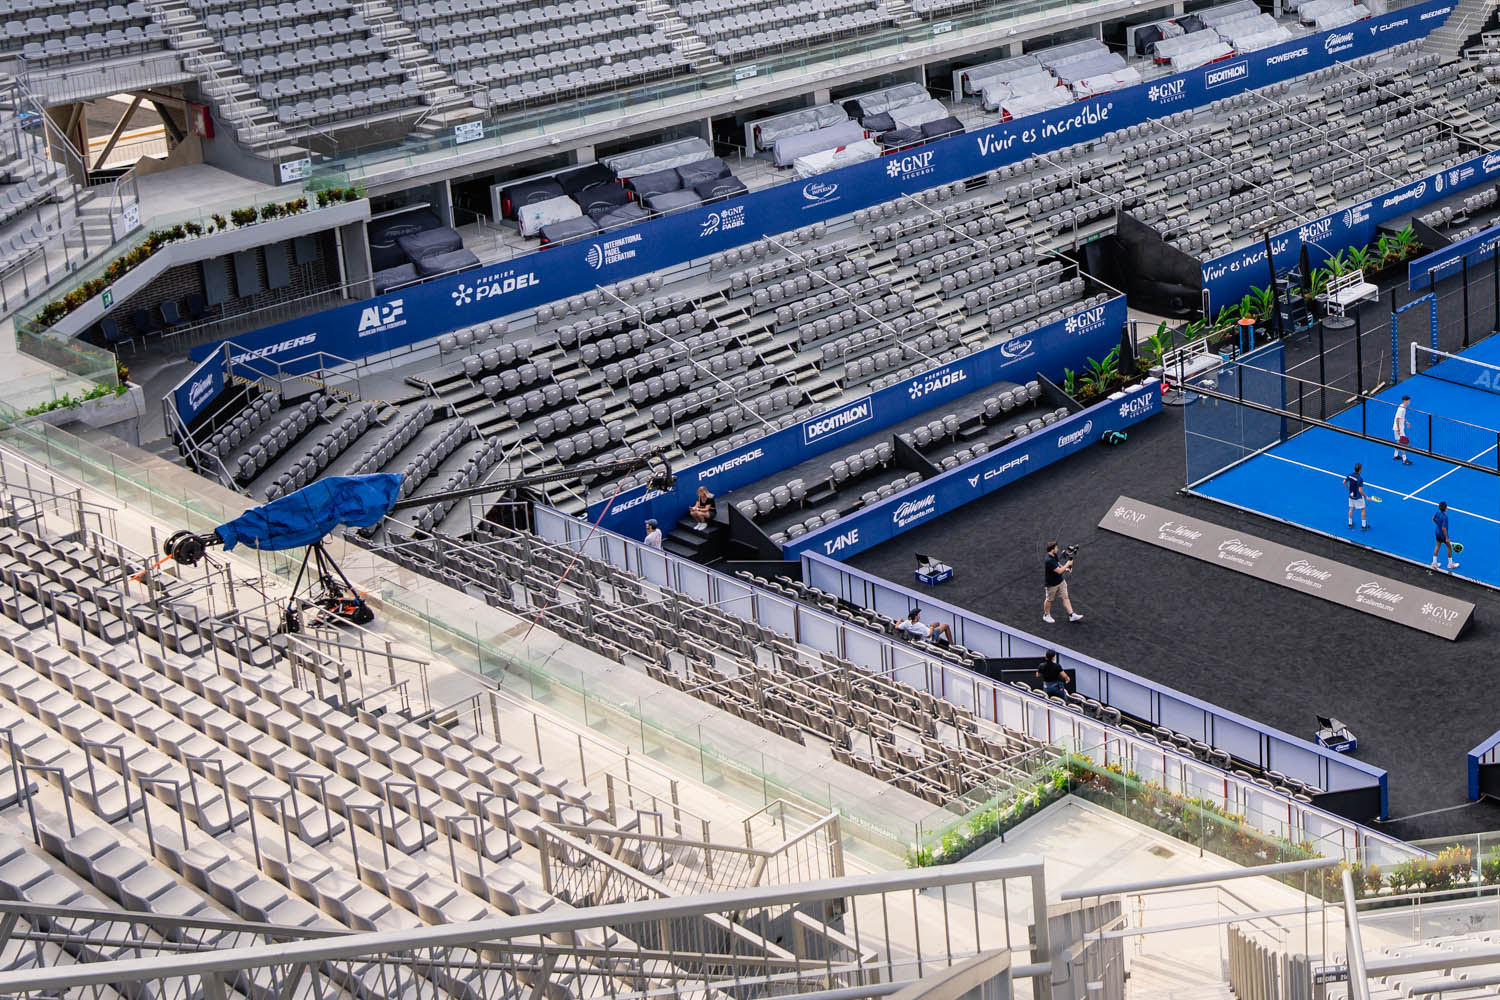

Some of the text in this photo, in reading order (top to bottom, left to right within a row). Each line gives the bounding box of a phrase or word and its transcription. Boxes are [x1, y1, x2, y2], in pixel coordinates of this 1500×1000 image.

[1379, 19, 1408, 32] CUPRA
[1266, 47, 1308, 67] POWERADE
[1208, 64, 1247, 85] DECATHLON
[1159, 79, 1185, 97] GNP
[977, 103, 1109, 157] Vivir es increíble
[902, 151, 933, 172] GNP
[902, 168, 934, 181] SEGUROS
[728, 206, 744, 216] GNP
[1309, 219, 1330, 236] GNP
[603, 233, 642, 249] INTERNATIONAL
[604, 247, 620, 257] PADEL
[604, 250, 636, 265] FEDERATION
[1202, 240, 1284, 284] Vivir es increble
[476, 272, 540, 301] PADEL
[477, 269, 515, 285] PREMIER
[1077, 306, 1104, 327] GNP
[230, 332, 317, 365] SKECHERS
[924, 368, 967, 394] PADEL
[1129, 394, 1152, 417] GNP
[808, 403, 868, 438] DECATHLON
[698, 448, 764, 481] POWERADE
[984, 454, 1029, 481] CUPRA
[611, 487, 672, 515] SKECHE
[893, 494, 936, 523] Caliente
[1122, 509, 1146, 523] GNP
[1159, 521, 1202, 540] Cliente
[824, 528, 860, 555] TANE
[1218, 538, 1263, 559] Caliente
[1285, 559, 1332, 581] Caliente
[1355, 581, 1404, 603] Caliente
[1432, 606, 1458, 622] GNP
